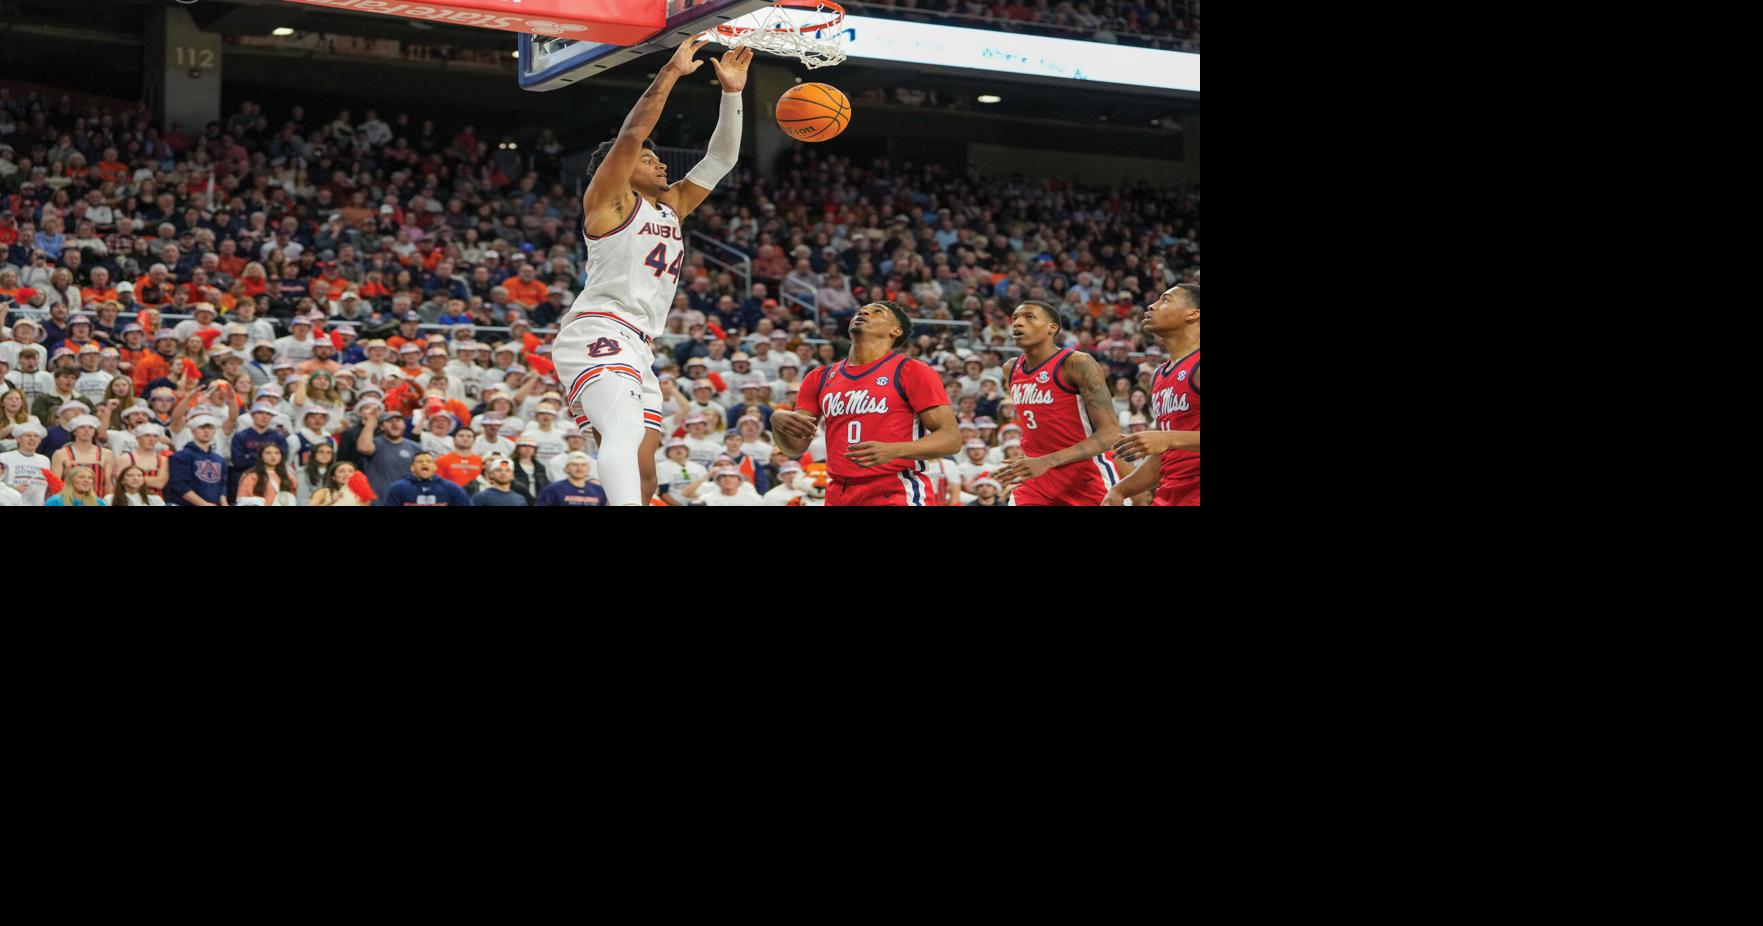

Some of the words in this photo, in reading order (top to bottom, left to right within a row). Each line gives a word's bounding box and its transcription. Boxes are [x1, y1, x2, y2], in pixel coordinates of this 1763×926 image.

[176, 46, 214, 68] 112
[638, 222, 683, 241] AUBU
[643, 242, 684, 285] 44
[822, 391, 845, 418] Ole
[845, 389, 889, 415] Miss
[1022, 383, 1054, 405] Miss
[1160, 386, 1189, 415] Miss
[1023, 410, 1038, 430] 3
[847, 420, 862, 444] 0
